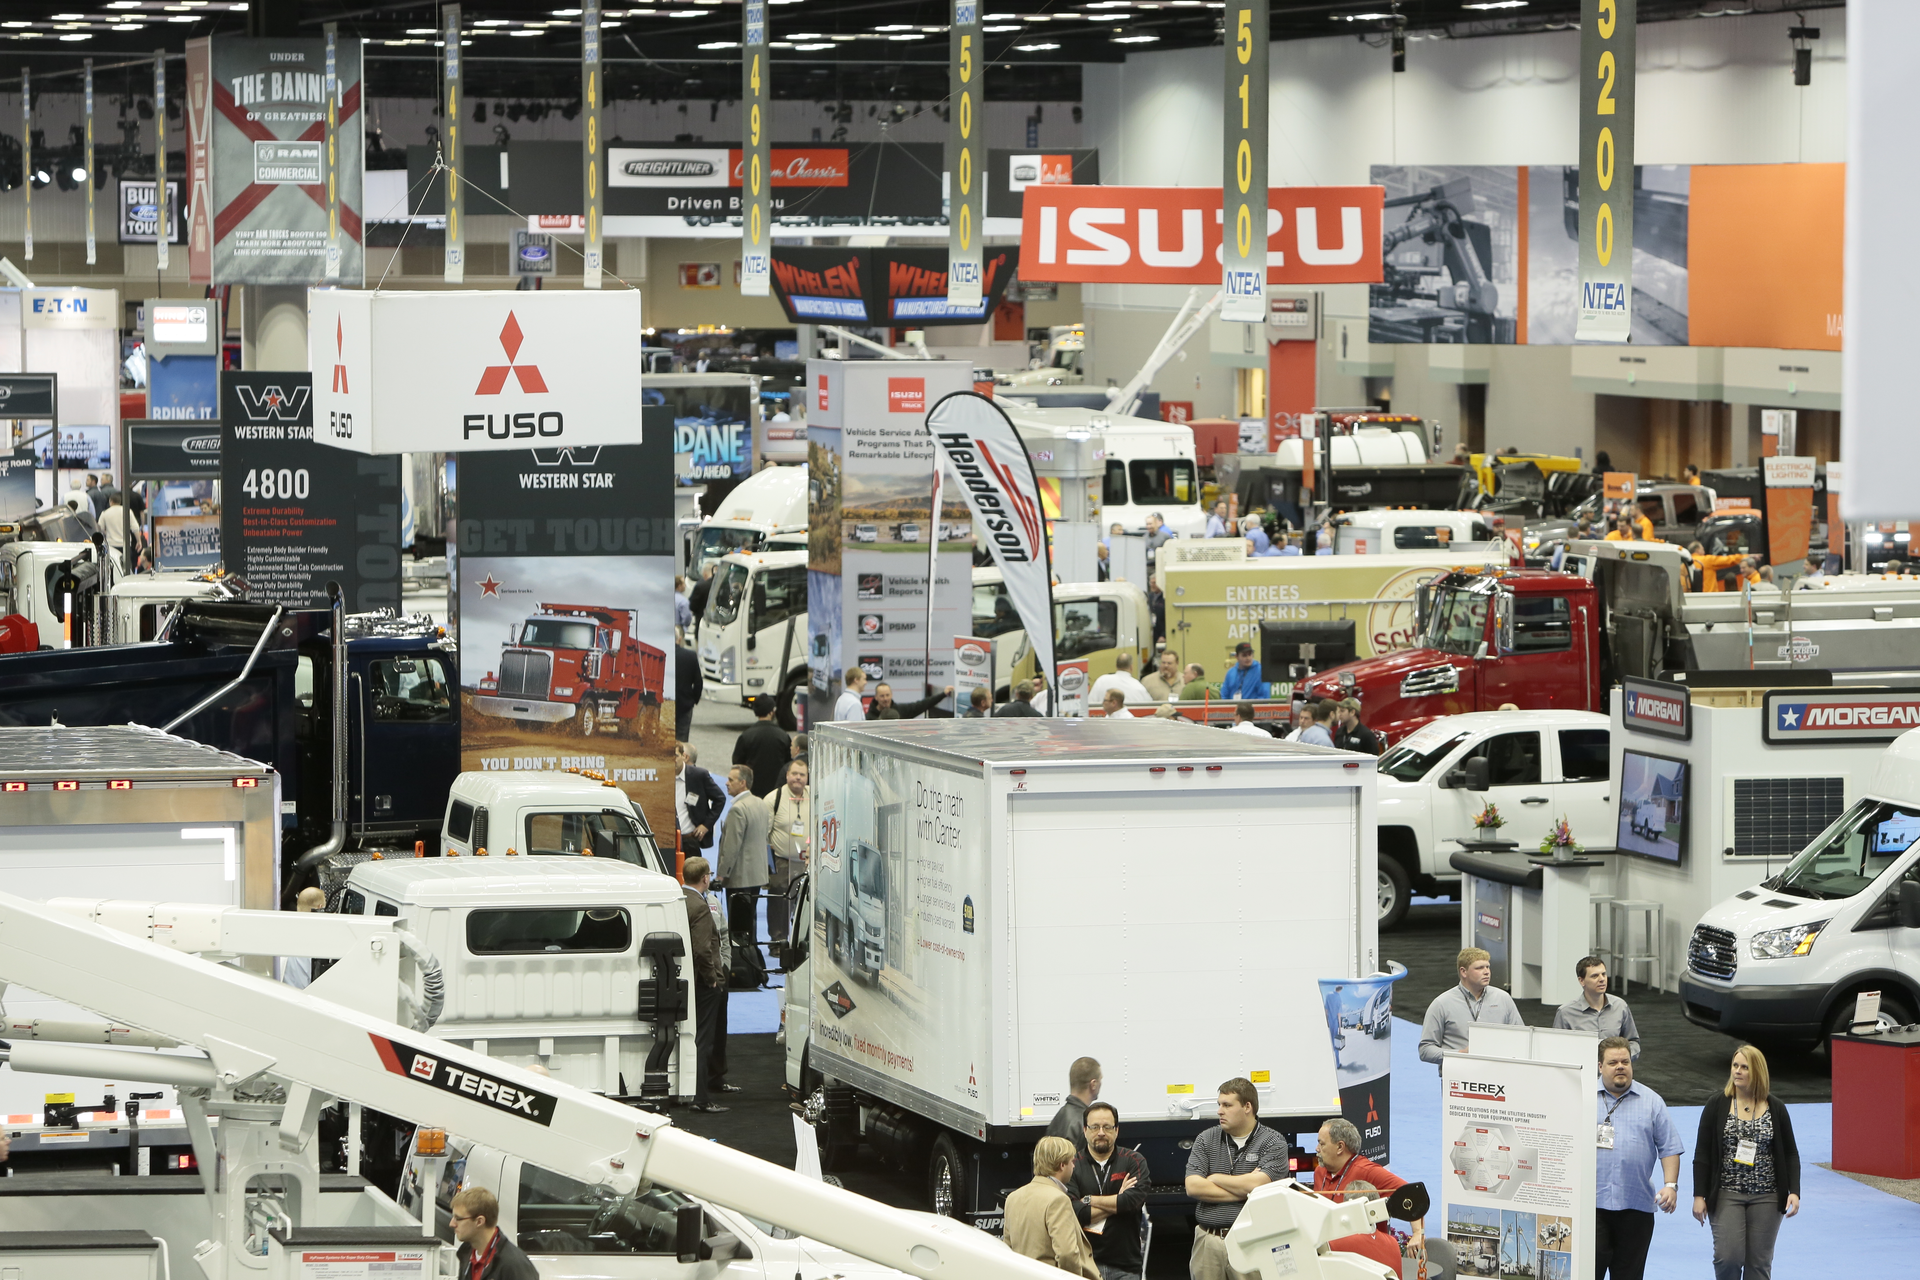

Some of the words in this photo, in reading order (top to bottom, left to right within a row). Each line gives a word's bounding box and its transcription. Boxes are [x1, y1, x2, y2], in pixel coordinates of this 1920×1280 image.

[956, 7, 976, 24] SHOW
[747, 28, 764, 44] SHOW
[270, 52, 304, 62] UNDER
[232, 73, 266, 107] THE
[246, 112, 262, 122] OF
[264, 112, 326, 121] GREATNES
[1236, 9, 1252, 258] 5100
[1596, 0, 1616, 266] 5200
[750, 54, 760, 245] 4900
[959, 35, 972, 250] 5000
[277, 149, 318, 158] RAM
[588, 72, 596, 243] 4800
[448, 86, 457, 241] 4700
[628, 162, 711, 174] FREIGHTLINER
[786, 158, 844, 179] Chassis
[259, 167, 318, 180] COMMERCIAL
[126, 188, 172, 204] BUIT
[668, 197, 722, 209] Driven
[518, 234, 550, 245] BUILT
[518, 260, 550, 270] TOUGH
[744, 254, 767, 274] NTEA
[771, 258, 861, 297] WHELEN
[889, 259, 998, 297] WHELN
[951, 262, 979, 283] NTEA
[1226, 271, 1261, 296] NTEA
[1582, 282, 1625, 310] NTEA
[33, 298, 87, 313] EATON
[896, 301, 946, 315] MANUFACTURED
[234, 426, 285, 439] WESTERN
[288, 426, 313, 440] STAR
[330, 411, 353, 439] FUSO
[463, 412, 563, 440] FUSO
[846, 428, 876, 436] Vehicle
[857, 440, 900, 449] Programs
[10, 459, 32, 467] ROAD
[904, 451, 933, 460] Lifecyc
[703, 465, 731, 479] AHEAD
[1766, 463, 1813, 472] ELECTRICAL
[242, 468, 310, 499] 4800
[519, 474, 578, 488] WESTERN
[582, 473, 613, 488] STAR
[938, 433, 1029, 562] Henderson
[243, 507, 270, 515] Extreme
[272, 507, 304, 516] Durability
[185, 528, 215, 536] TOUGH
[460, 519, 534, 552] GET
[546, 517, 674, 552] TOUGH
[163, 546, 183, 557] OR
[247, 555, 264, 563] Highly
[266, 590, 283, 599] Range
[291, 590, 308, 598] Engine
[888, 588, 923, 596] Reports
[1226, 584, 1300, 601] ENTREES
[1227, 604, 1308, 620] DESSERTS
[1228, 623, 1260, 639] APP
[1636, 697, 1681, 722] MORGAN
[1806, 706, 1920, 726] MORGAN
[481, 758, 509, 770] YOU
[514, 757, 556, 770] DON'T
[561, 756, 605, 769] BRING
[614, 769, 658, 782] FIGHT.
[917, 781, 928, 808] Do
[930, 784, 942, 813] the
[944, 790, 964, 818] math
[917, 814, 933, 842] with
[935, 816, 962, 849] Canter.
[920, 936, 932, 950] Lower
[819, 1020, 843, 1047] Incredibly
[853, 1034, 866, 1054] fixed
[867, 1040, 886, 1065] monthly
[888, 1050, 914, 1072] payments!
[444, 1066, 536, 1114] TEREX
[1461, 1081, 1505, 1096] TEREX
[1365, 1126, 1382, 1139] FUSO
